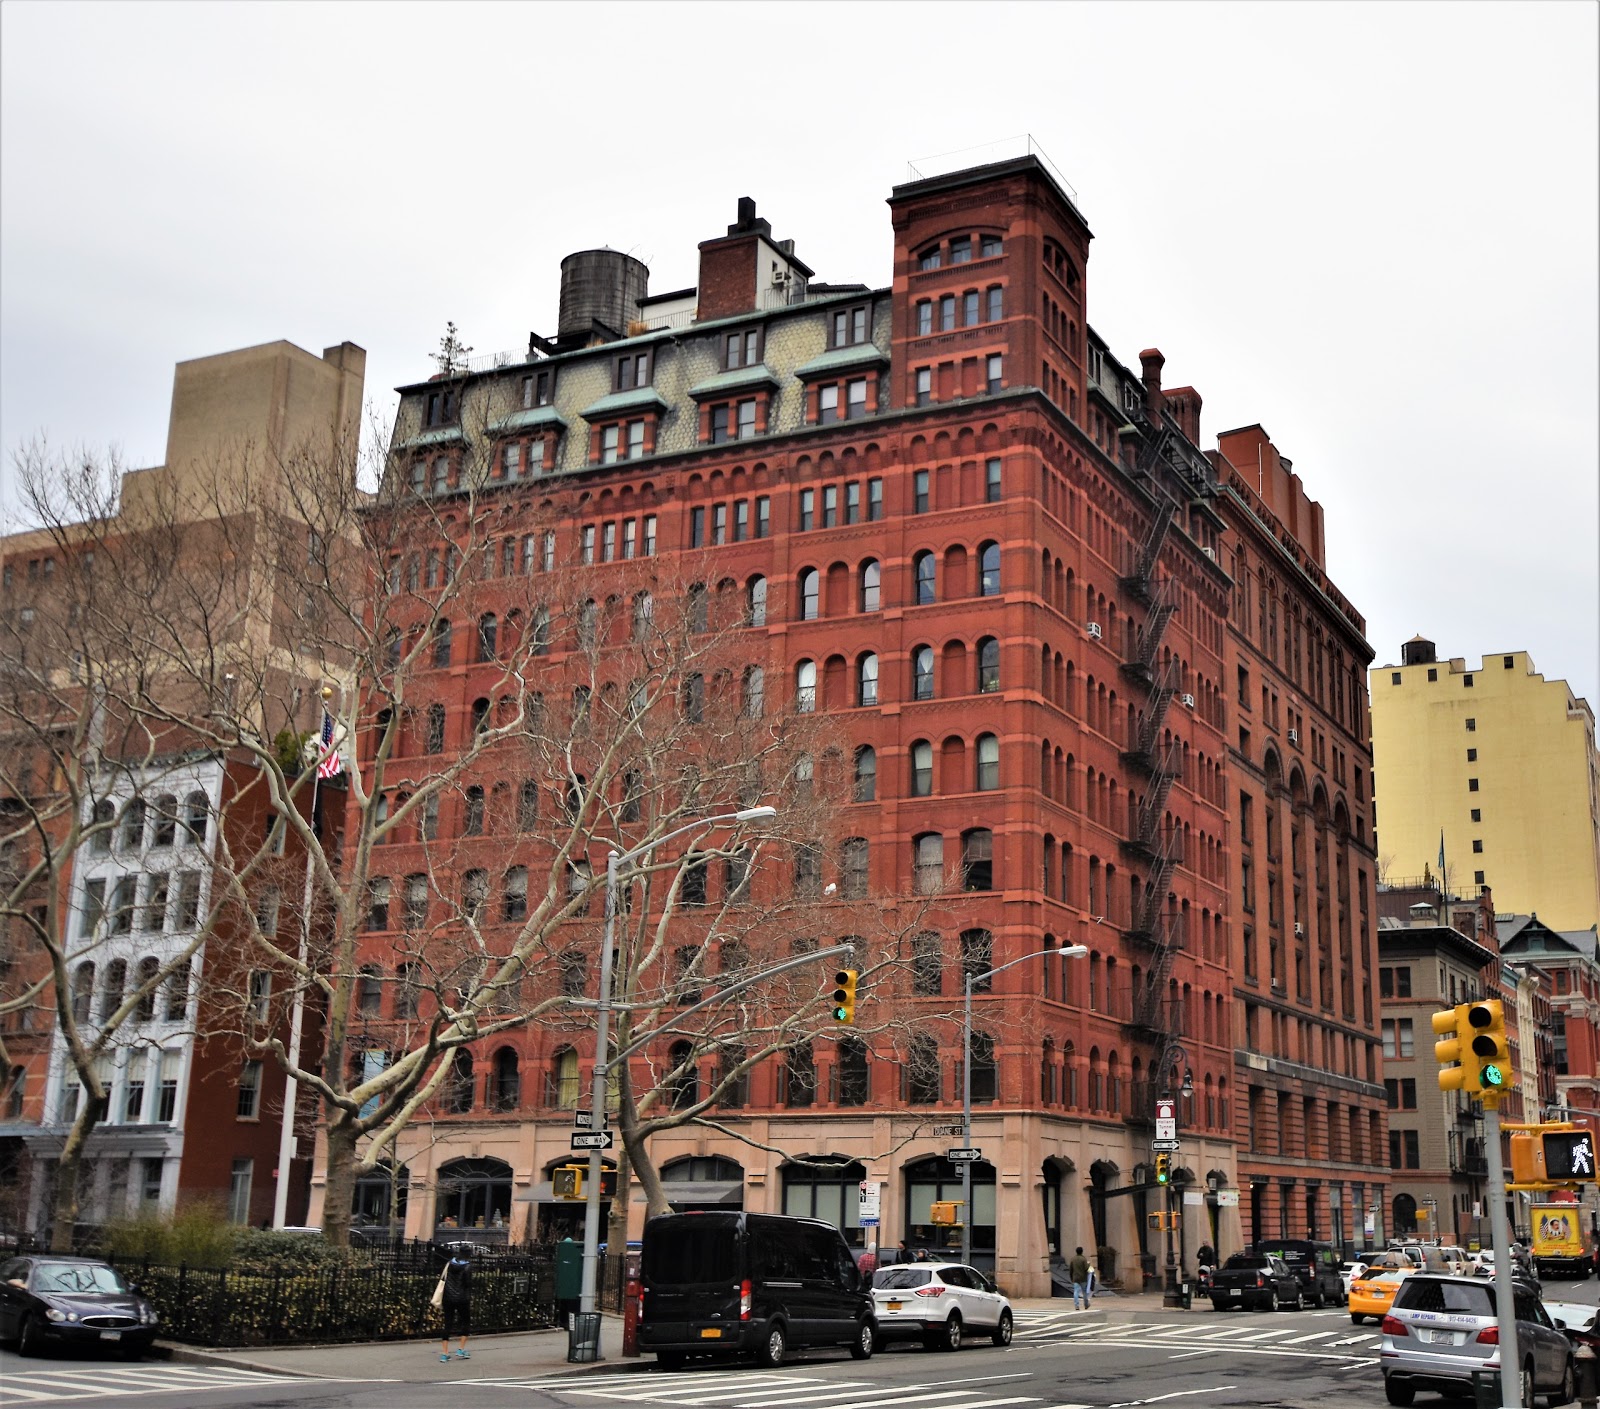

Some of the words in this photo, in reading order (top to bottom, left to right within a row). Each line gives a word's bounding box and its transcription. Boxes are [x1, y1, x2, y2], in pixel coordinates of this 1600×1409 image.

[579, 1115, 590, 1124] ONE
[954, 1127, 962, 1135] ST
[576, 1137, 589, 1145] ONE
[593, 1136, 607, 1144] WAY
